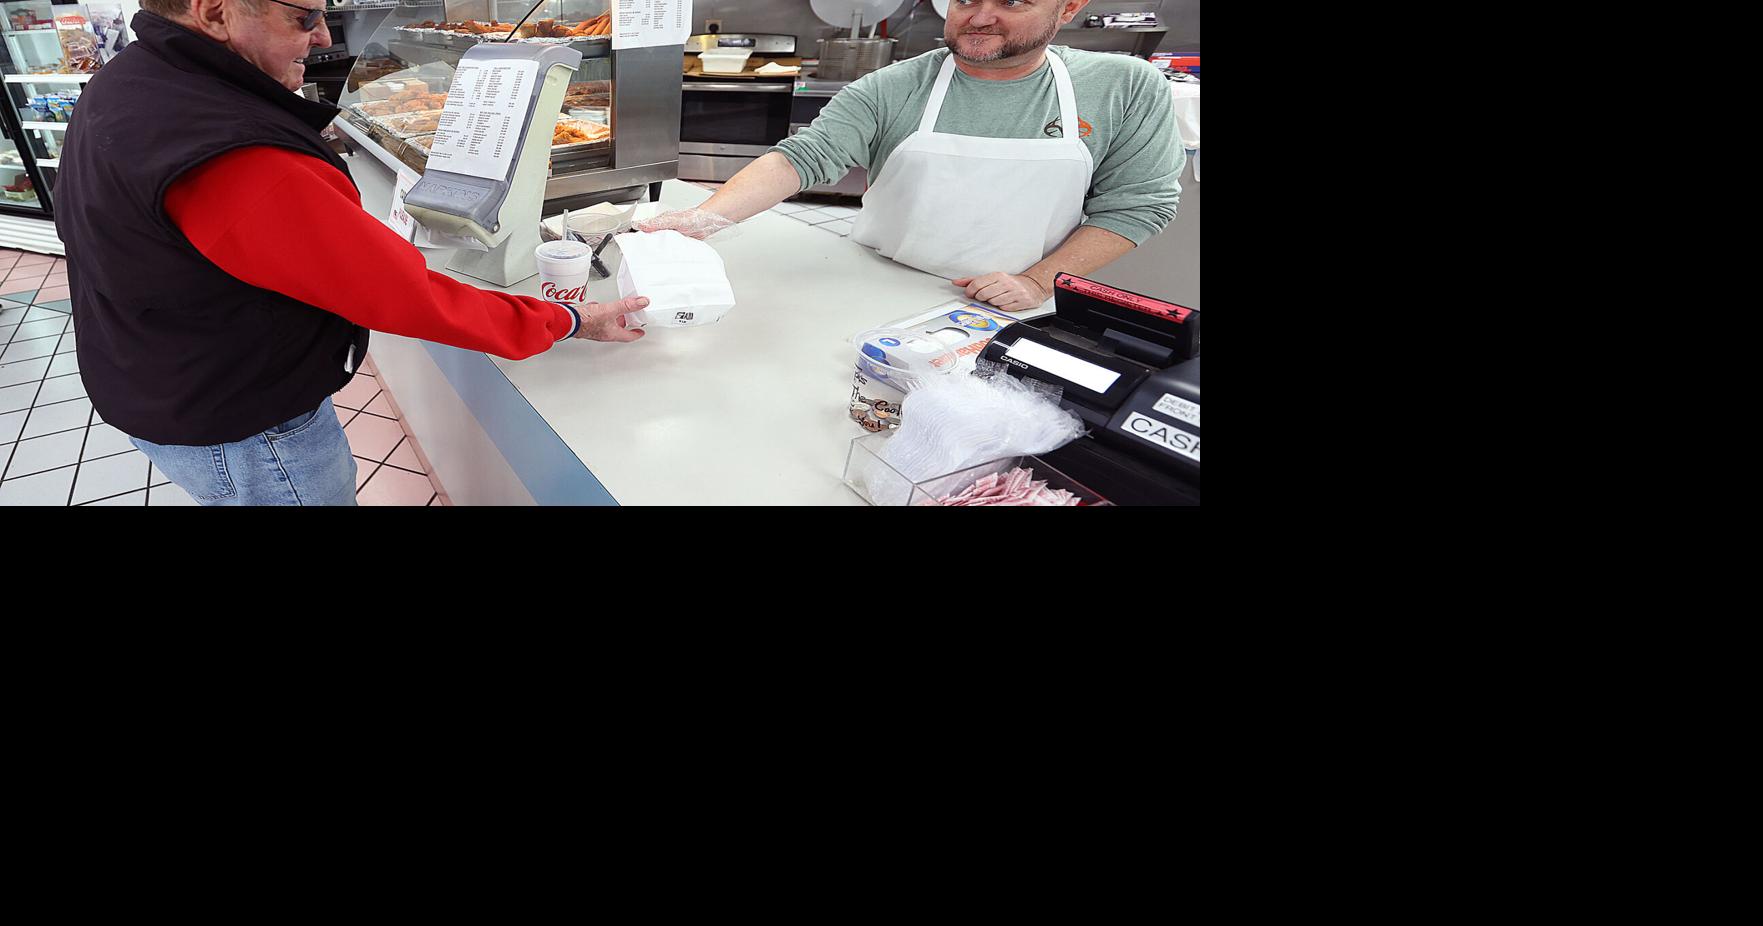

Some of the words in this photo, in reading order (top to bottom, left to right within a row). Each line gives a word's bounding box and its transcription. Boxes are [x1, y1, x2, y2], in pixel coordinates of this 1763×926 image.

[1000, 355, 1029, 370] CASIO
[1159, 402, 1196, 419] FRONT
[1163, 396, 1196, 411] DEBIT
